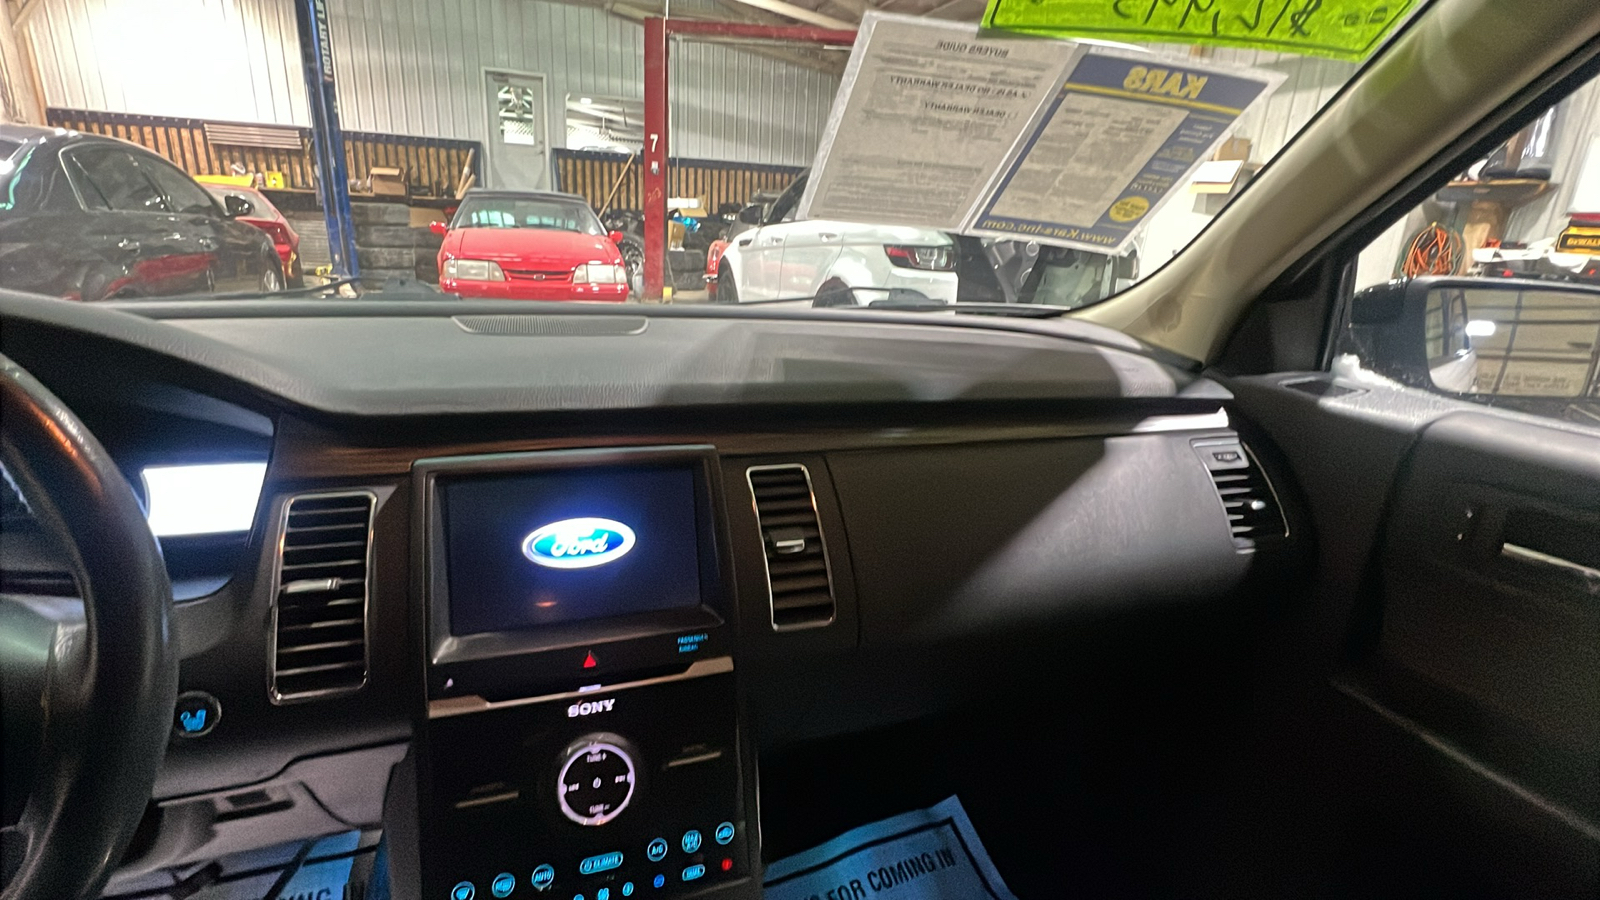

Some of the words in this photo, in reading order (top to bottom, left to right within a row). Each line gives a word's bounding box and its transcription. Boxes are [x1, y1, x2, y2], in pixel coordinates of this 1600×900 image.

[318, 20, 333, 75] ROTARY
[650, 133, 659, 153] 7
[567, 698, 616, 718] SONY
[867, 852, 936, 893] COMING
